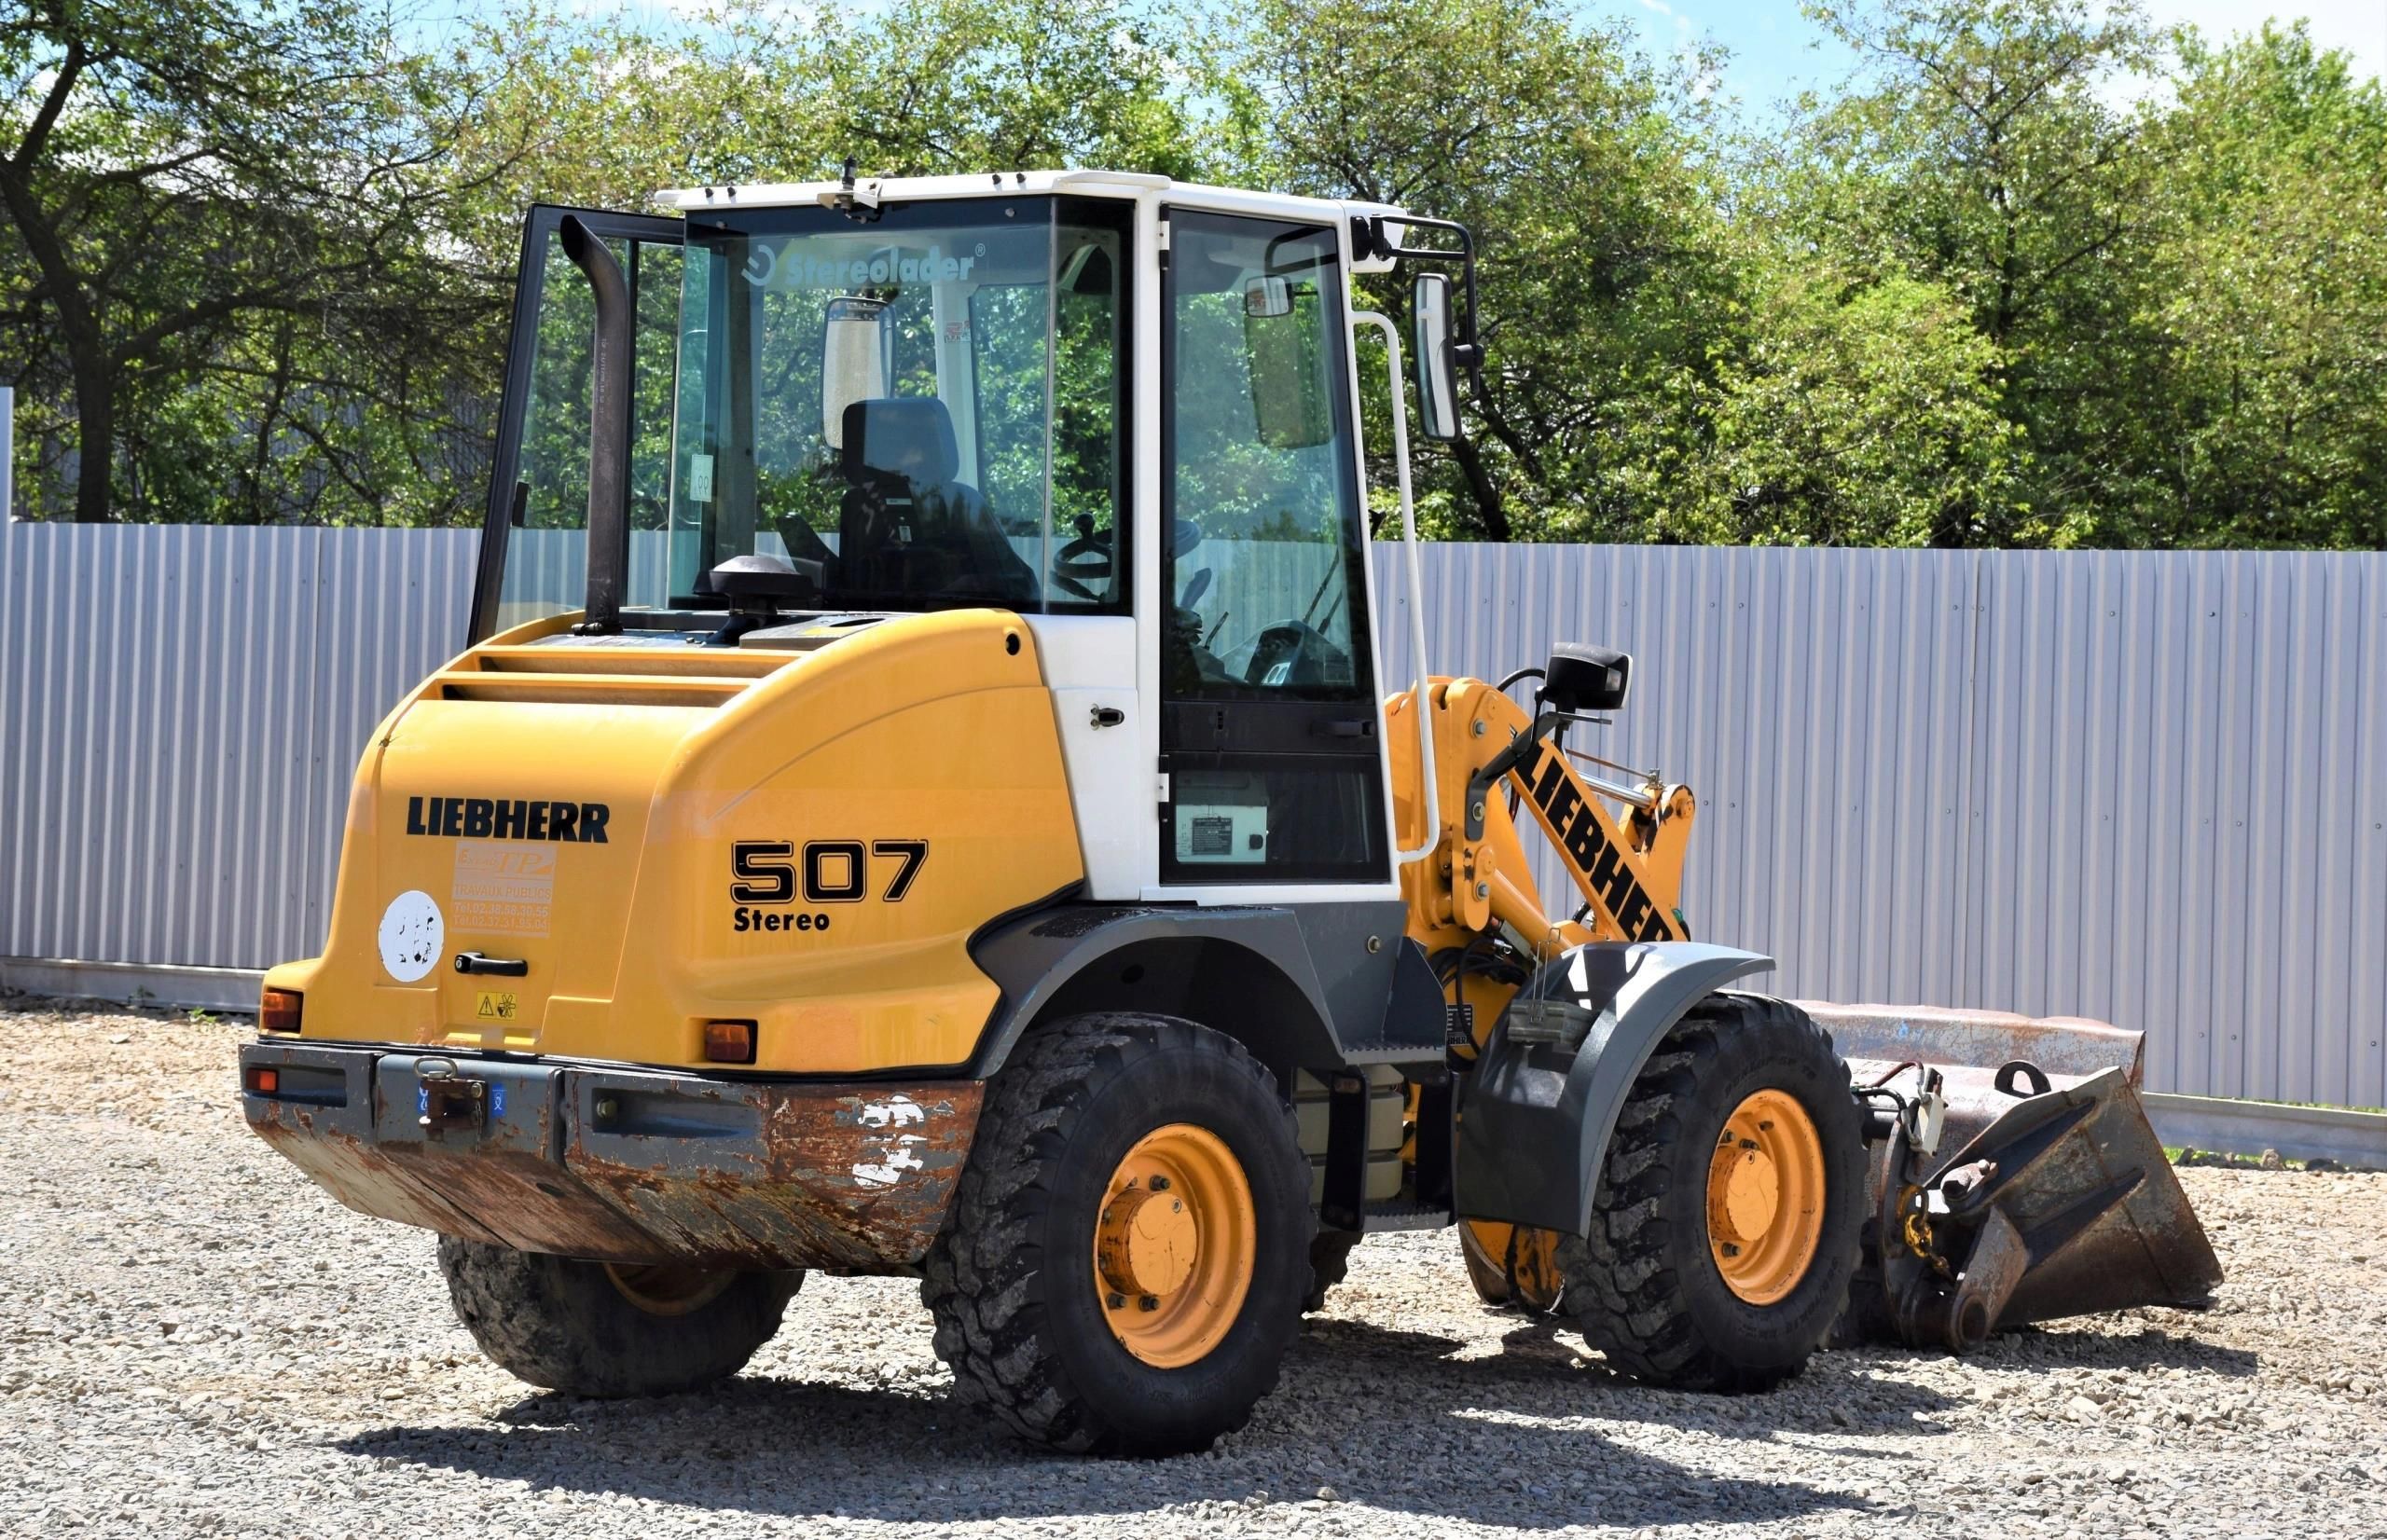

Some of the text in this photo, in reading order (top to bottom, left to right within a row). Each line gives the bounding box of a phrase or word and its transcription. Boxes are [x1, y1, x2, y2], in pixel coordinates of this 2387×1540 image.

[406, 796, 611, 844] LIEBHERR
[730, 839, 929, 904] 507
[455, 883, 552, 900] TRAVAUX PUBLICS
[734, 906, 830, 932] Stereo
